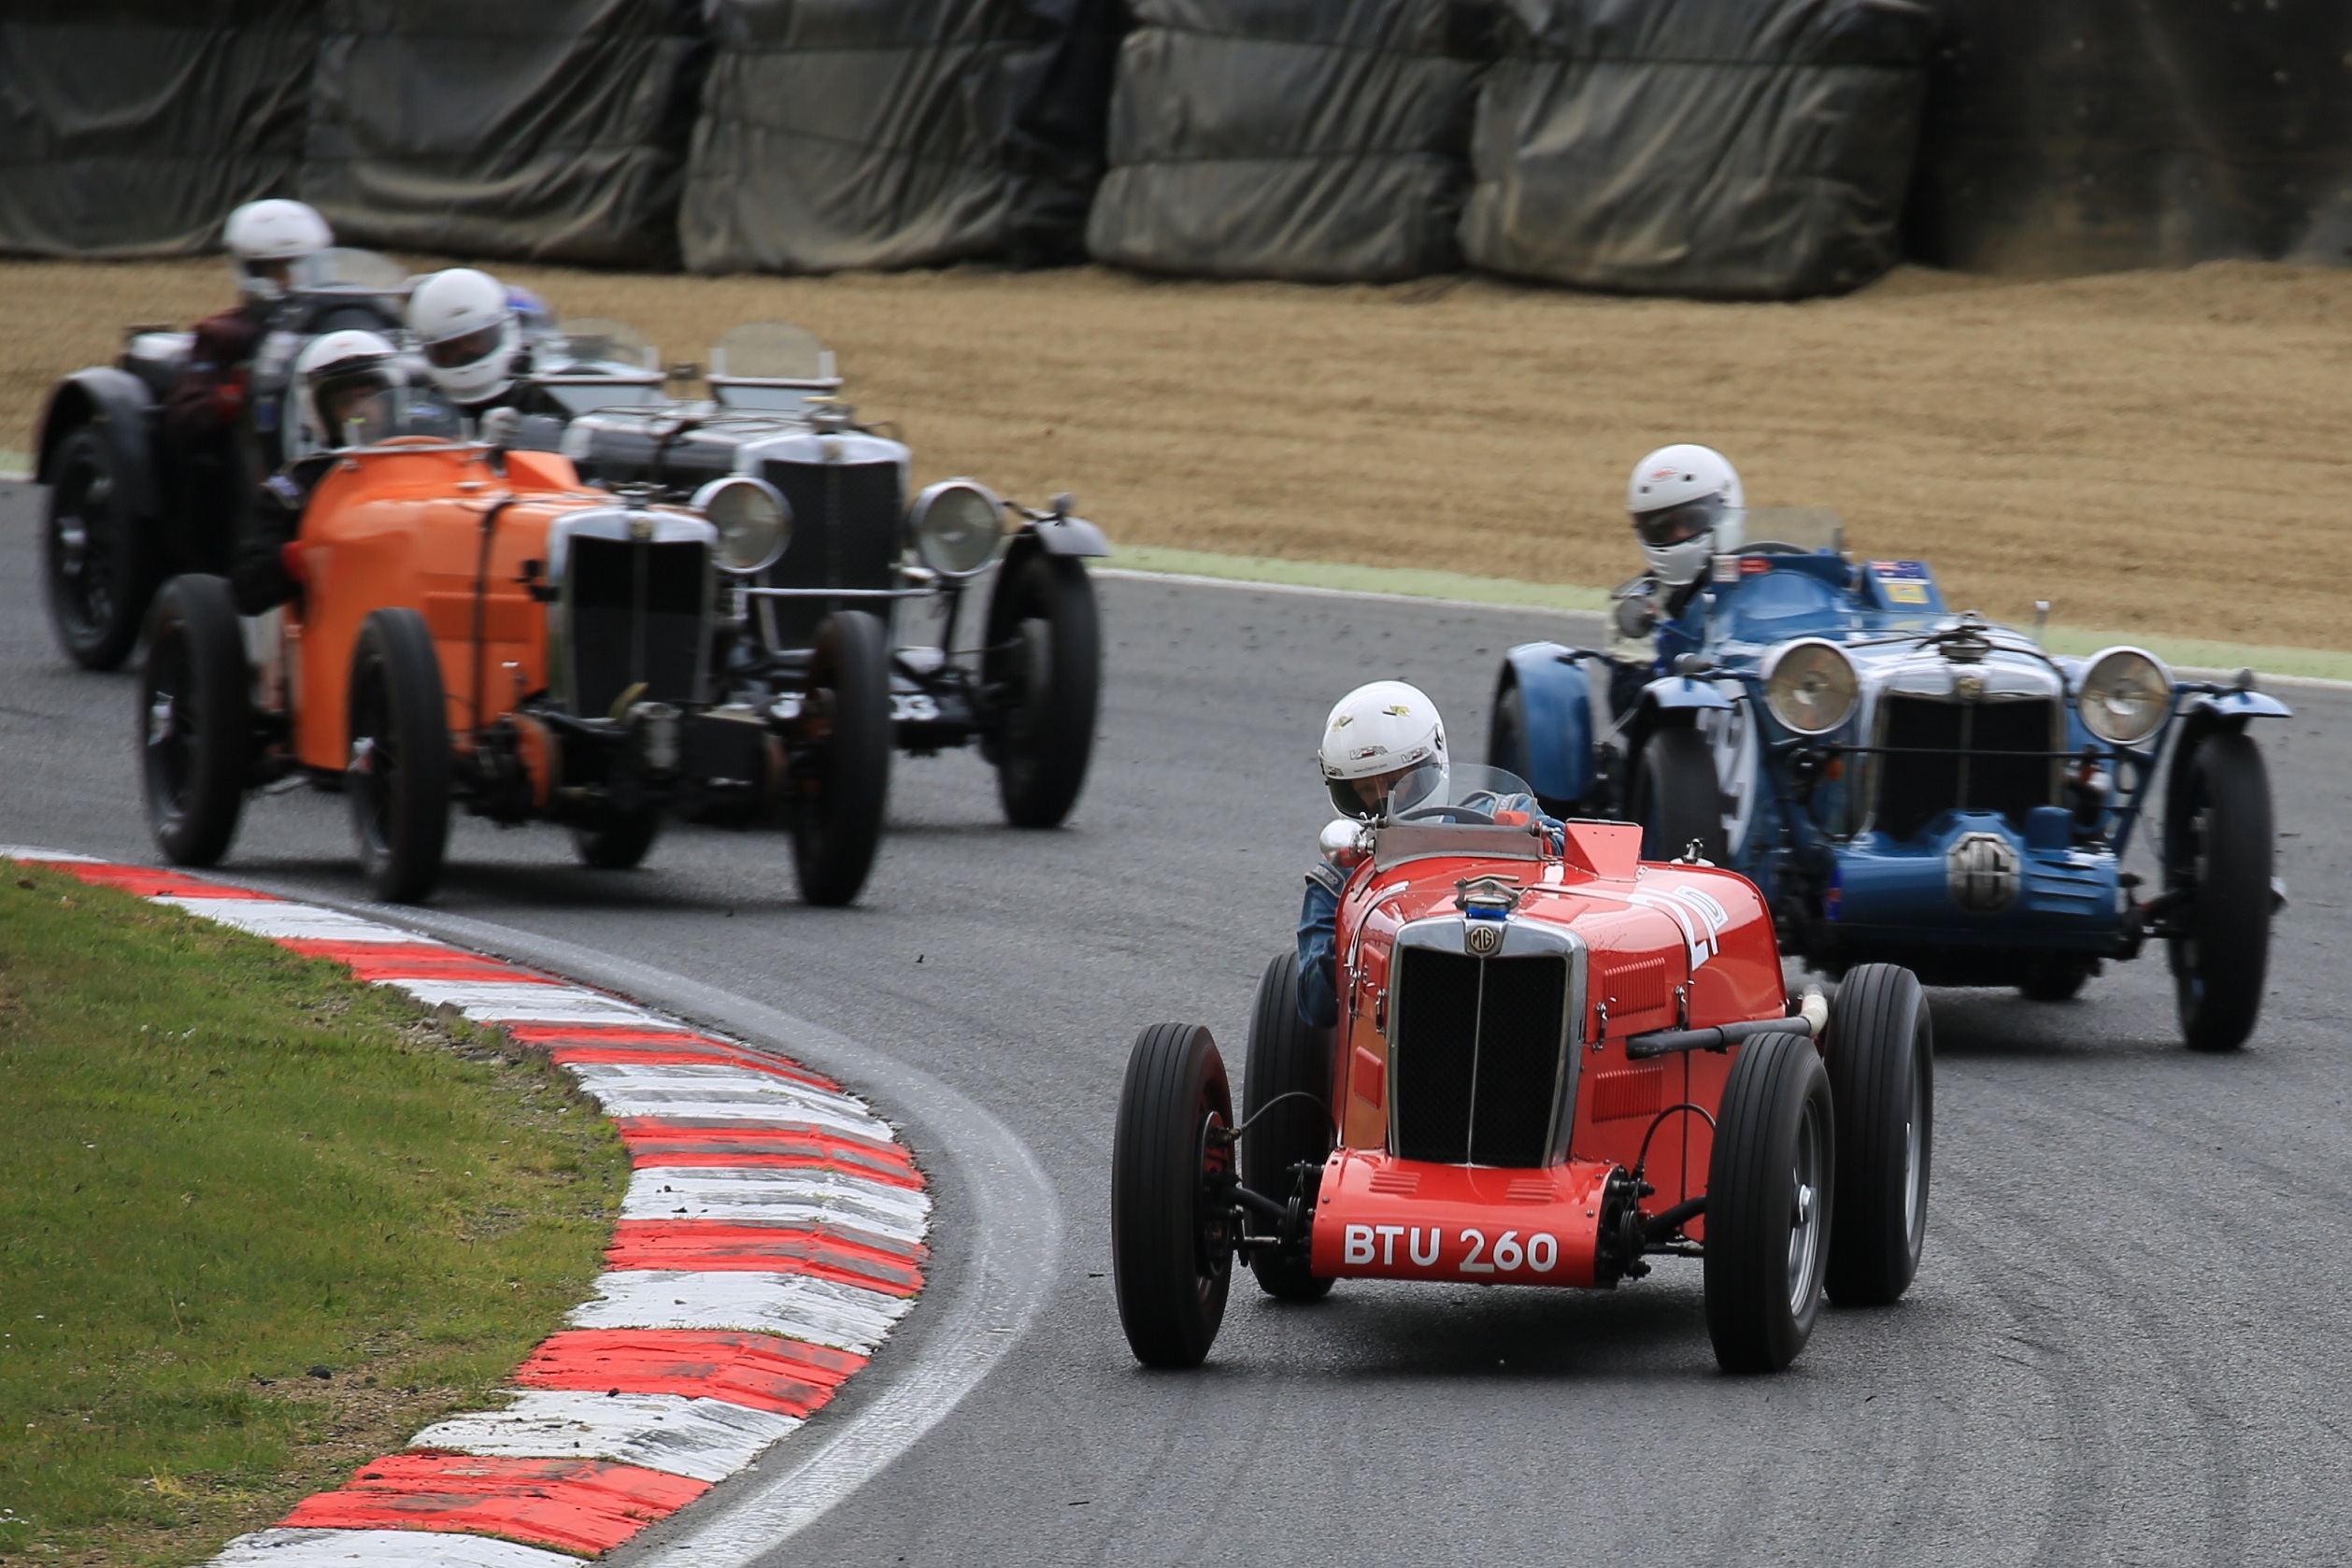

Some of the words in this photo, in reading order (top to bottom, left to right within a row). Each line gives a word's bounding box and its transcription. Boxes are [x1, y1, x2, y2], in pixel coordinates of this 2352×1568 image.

[1471, 927, 1494, 951] MG
[1344, 1223, 1441, 1266] BTU
[1459, 1228, 1558, 1273] 260
